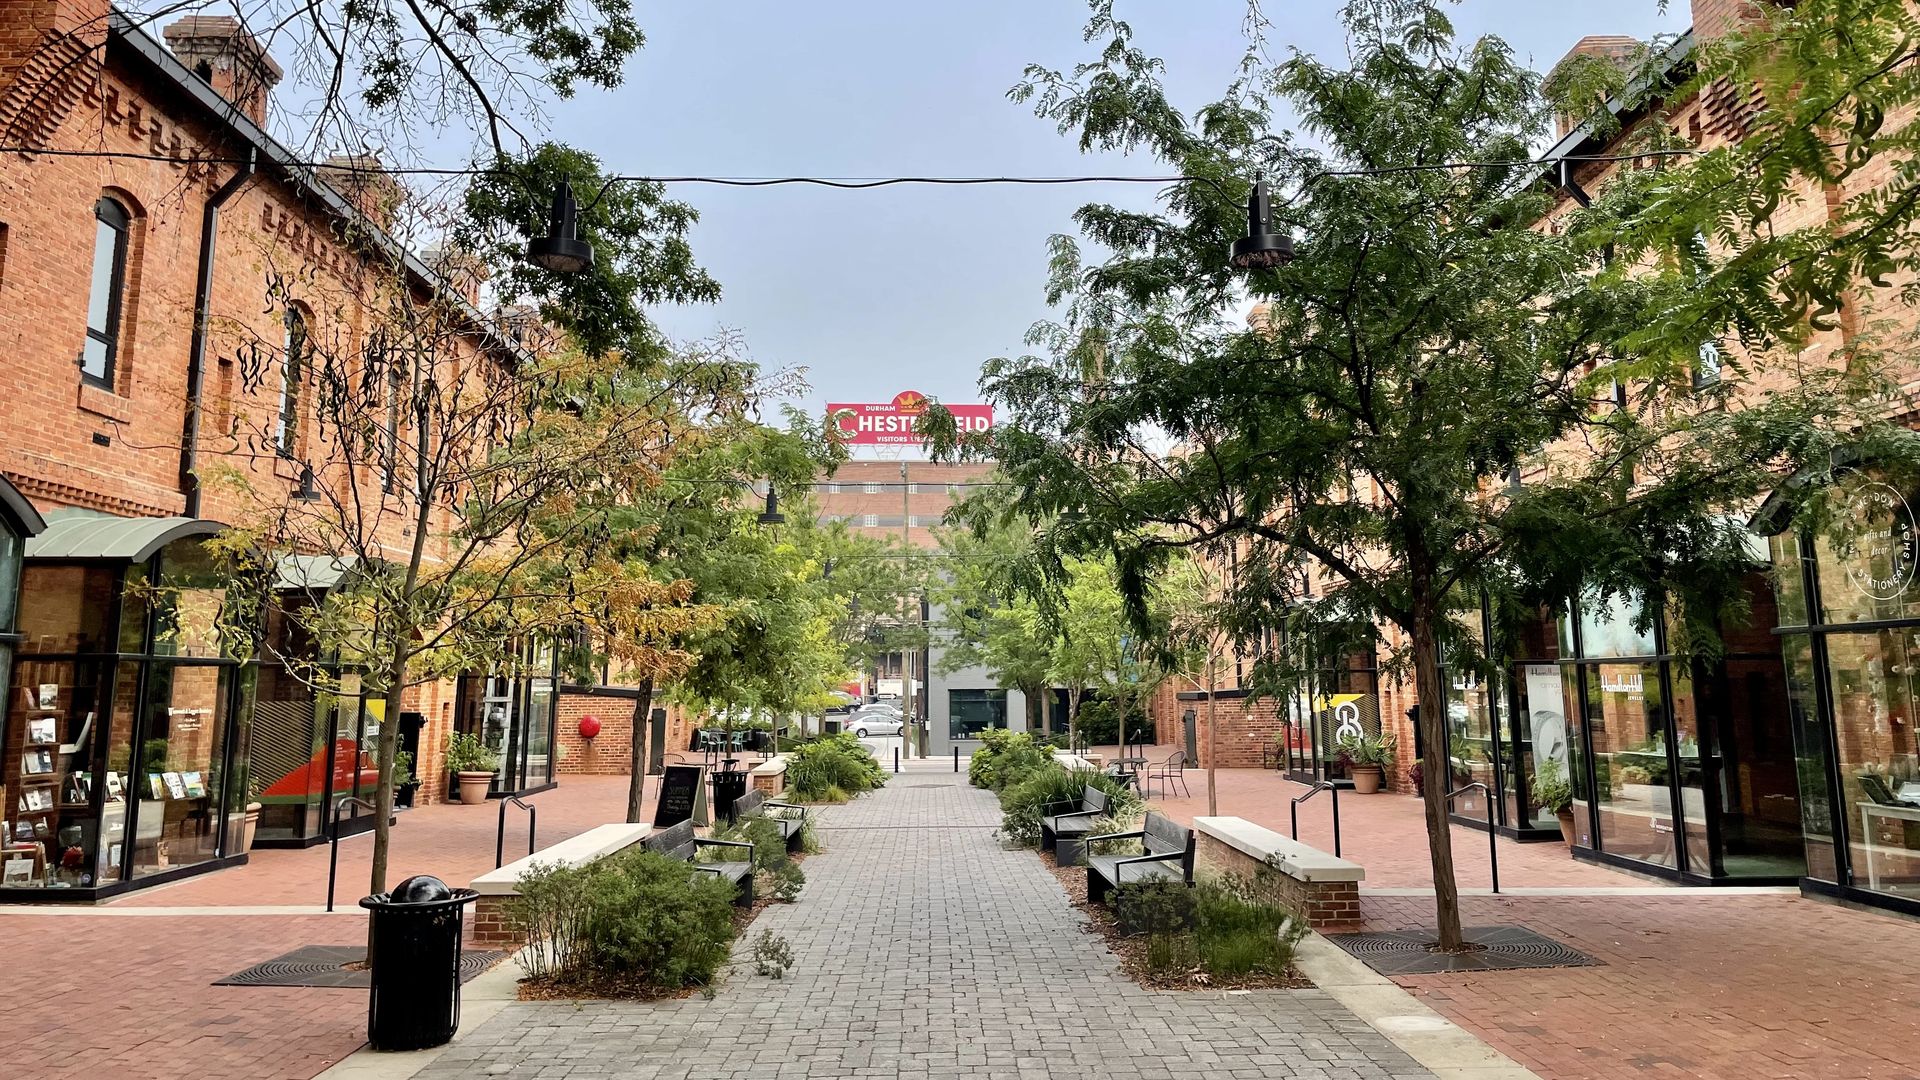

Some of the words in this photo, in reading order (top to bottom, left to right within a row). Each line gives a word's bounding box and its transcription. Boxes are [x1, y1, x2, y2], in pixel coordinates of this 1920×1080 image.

[1880, 526, 1891, 538] and
[1858, 561, 1906, 590] STATIONERY
[1901, 523, 1911, 559] SHOP
